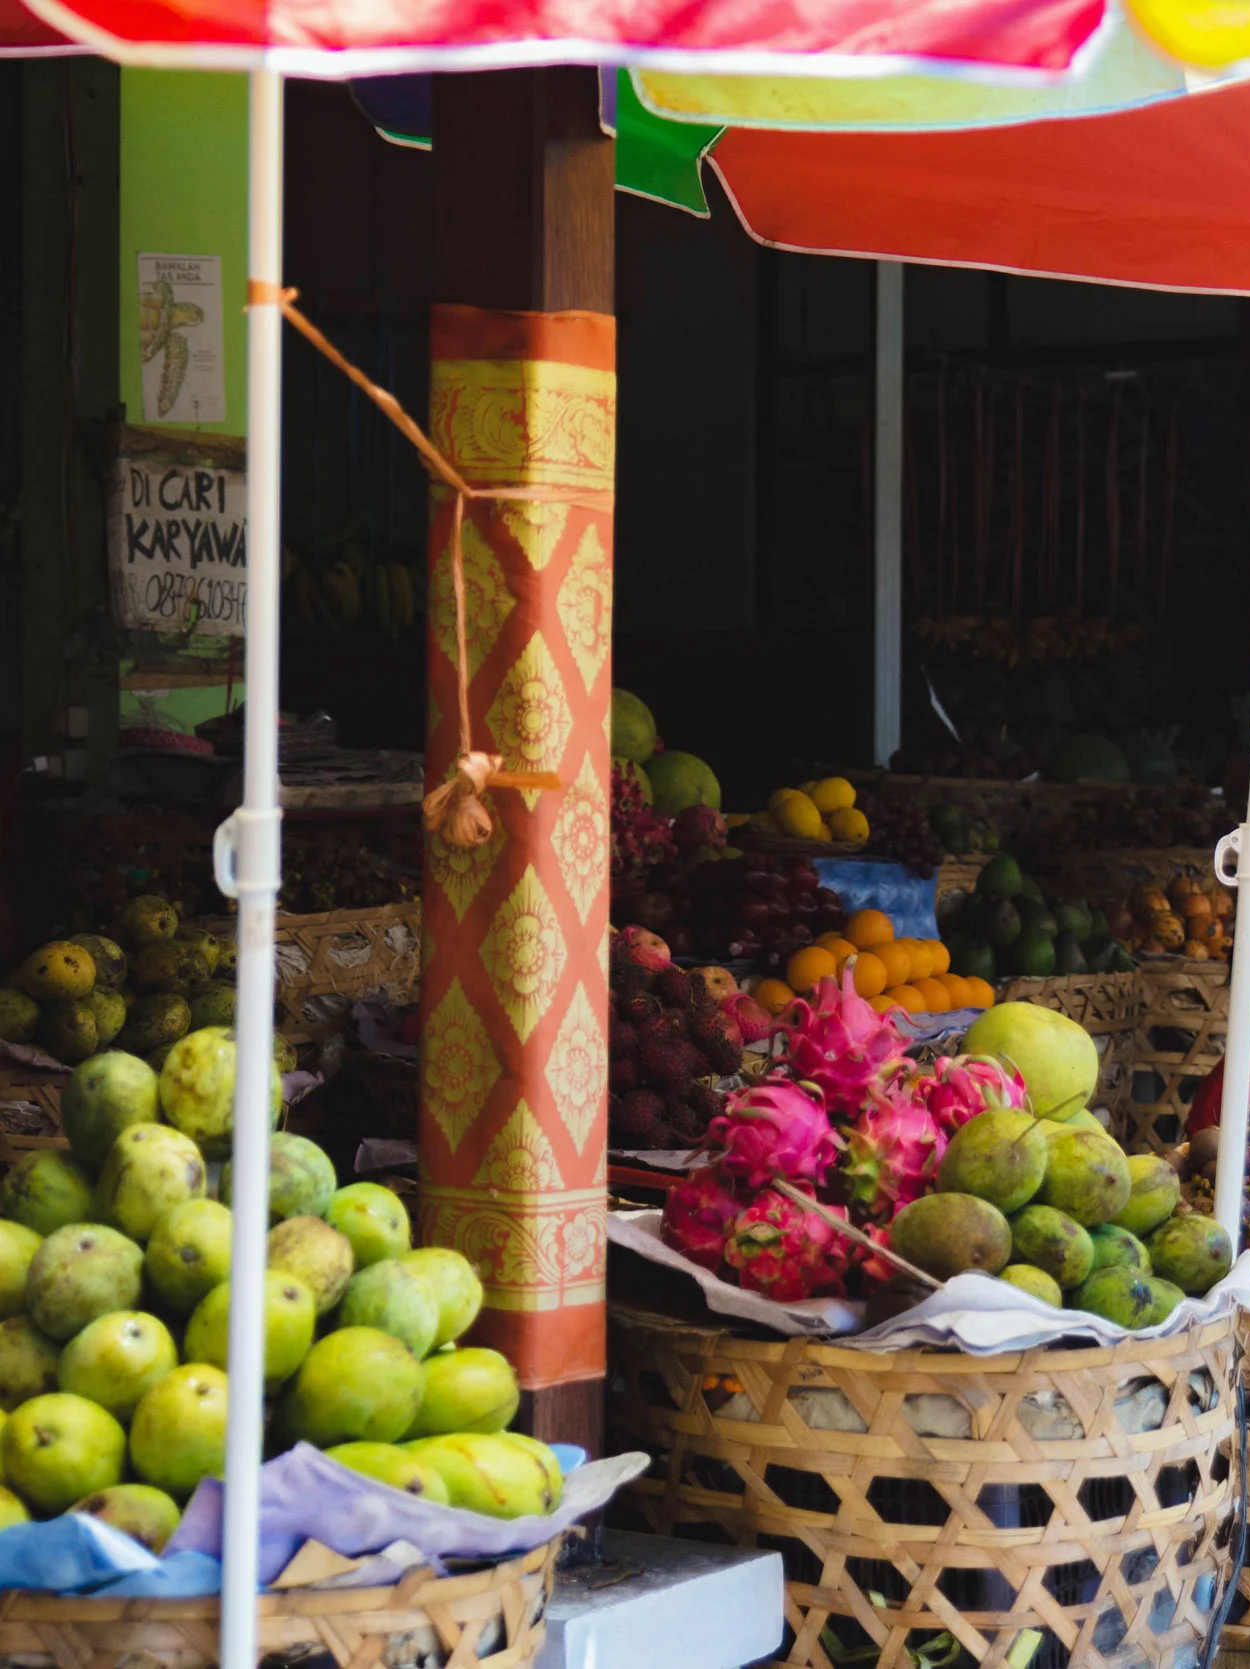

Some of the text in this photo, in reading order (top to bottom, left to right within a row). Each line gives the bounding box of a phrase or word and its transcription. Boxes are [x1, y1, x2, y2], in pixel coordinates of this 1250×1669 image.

[130, 467, 226, 513] DI CARI
[125, 512, 248, 570] KARYAWA
